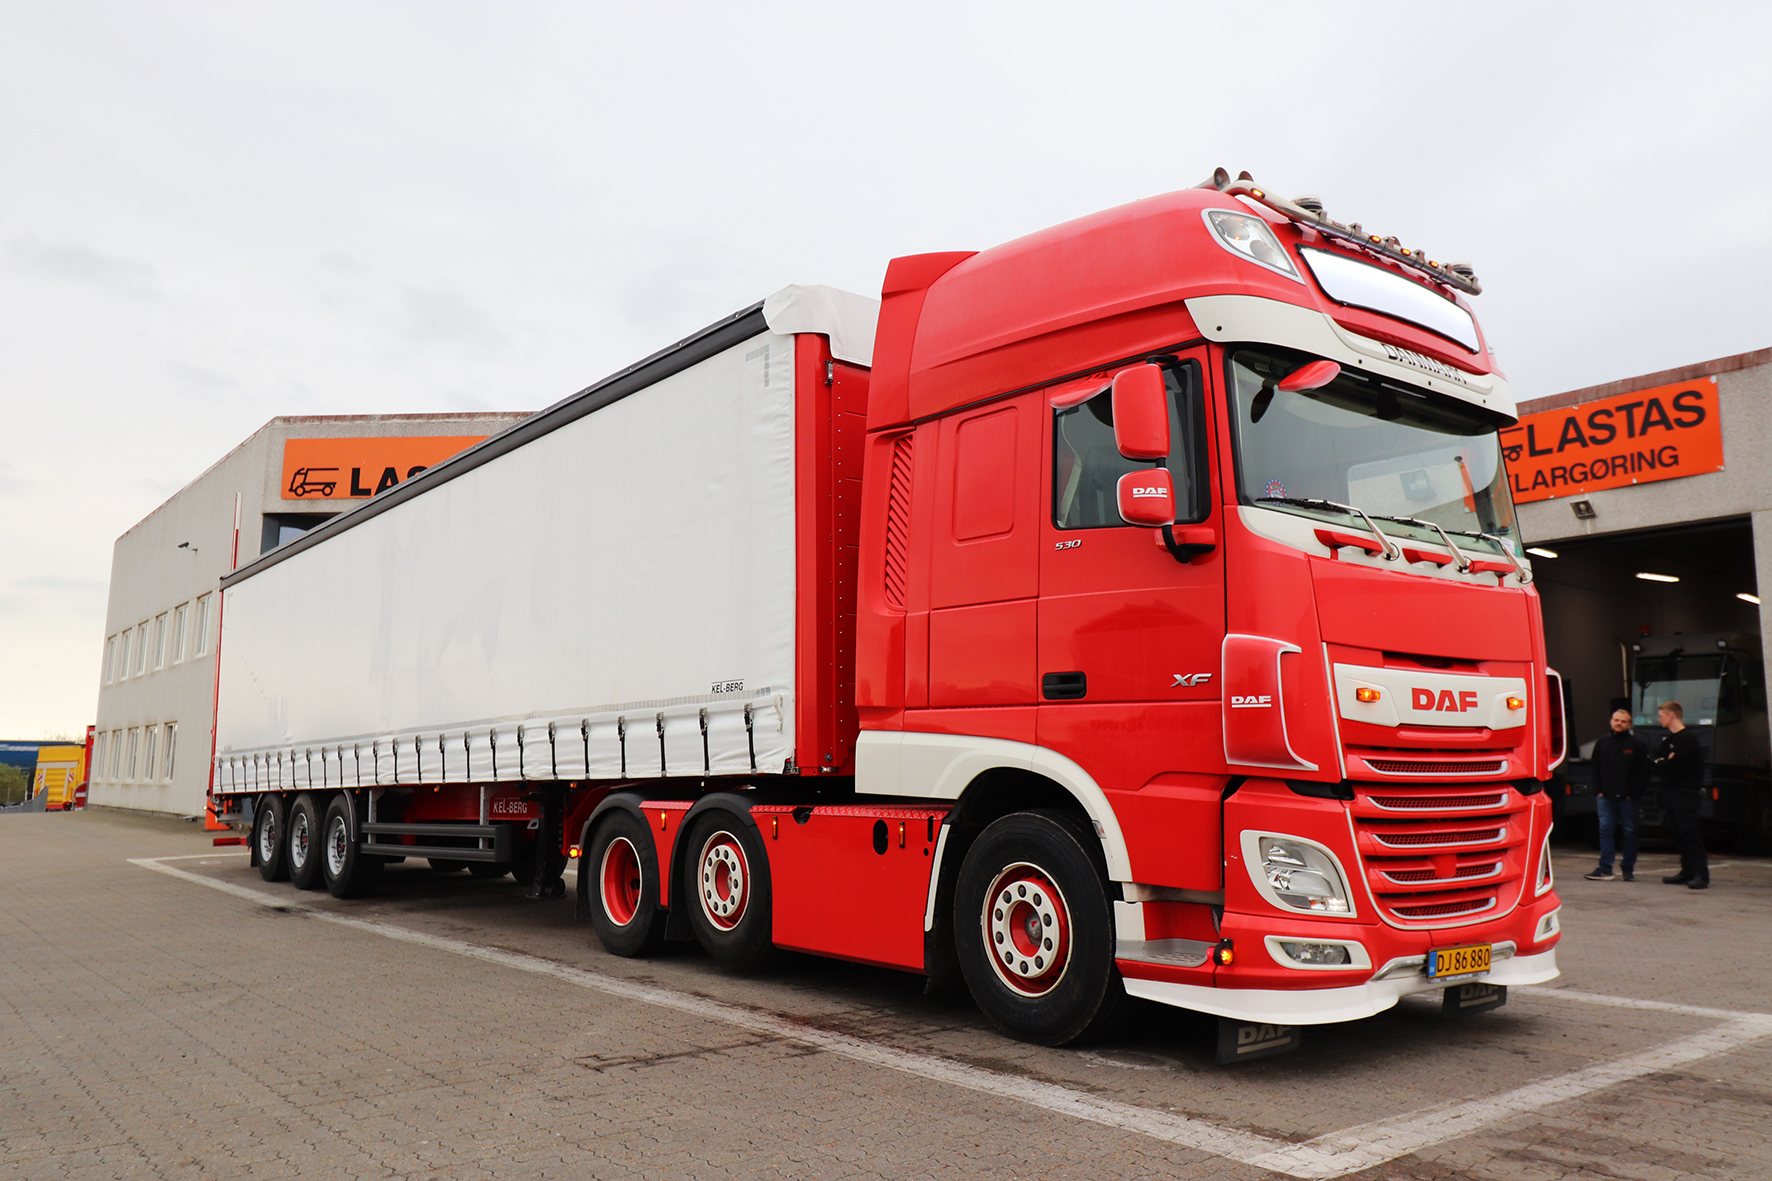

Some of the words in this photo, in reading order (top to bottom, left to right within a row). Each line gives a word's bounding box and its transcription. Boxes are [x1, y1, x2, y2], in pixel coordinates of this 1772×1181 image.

[1527, 390, 1706, 457] LASTAS
[1508, 446, 1679, 494] LARGØRING
[1132, 487, 1168, 495] DAF
[1055, 539, 1082, 551] 530
[711, 681, 744, 694] KEL-BERG
[1170, 673, 1213, 688] XF
[1231, 695, 1272, 704] DAF
[1411, 687, 1479, 713] DAF
[493, 798, 528, 814] KEL-BERG
[1437, 954, 1452, 972] DJ
[1454, 951, 1468, 970] 86
[1470, 948, 1490, 968] 880
